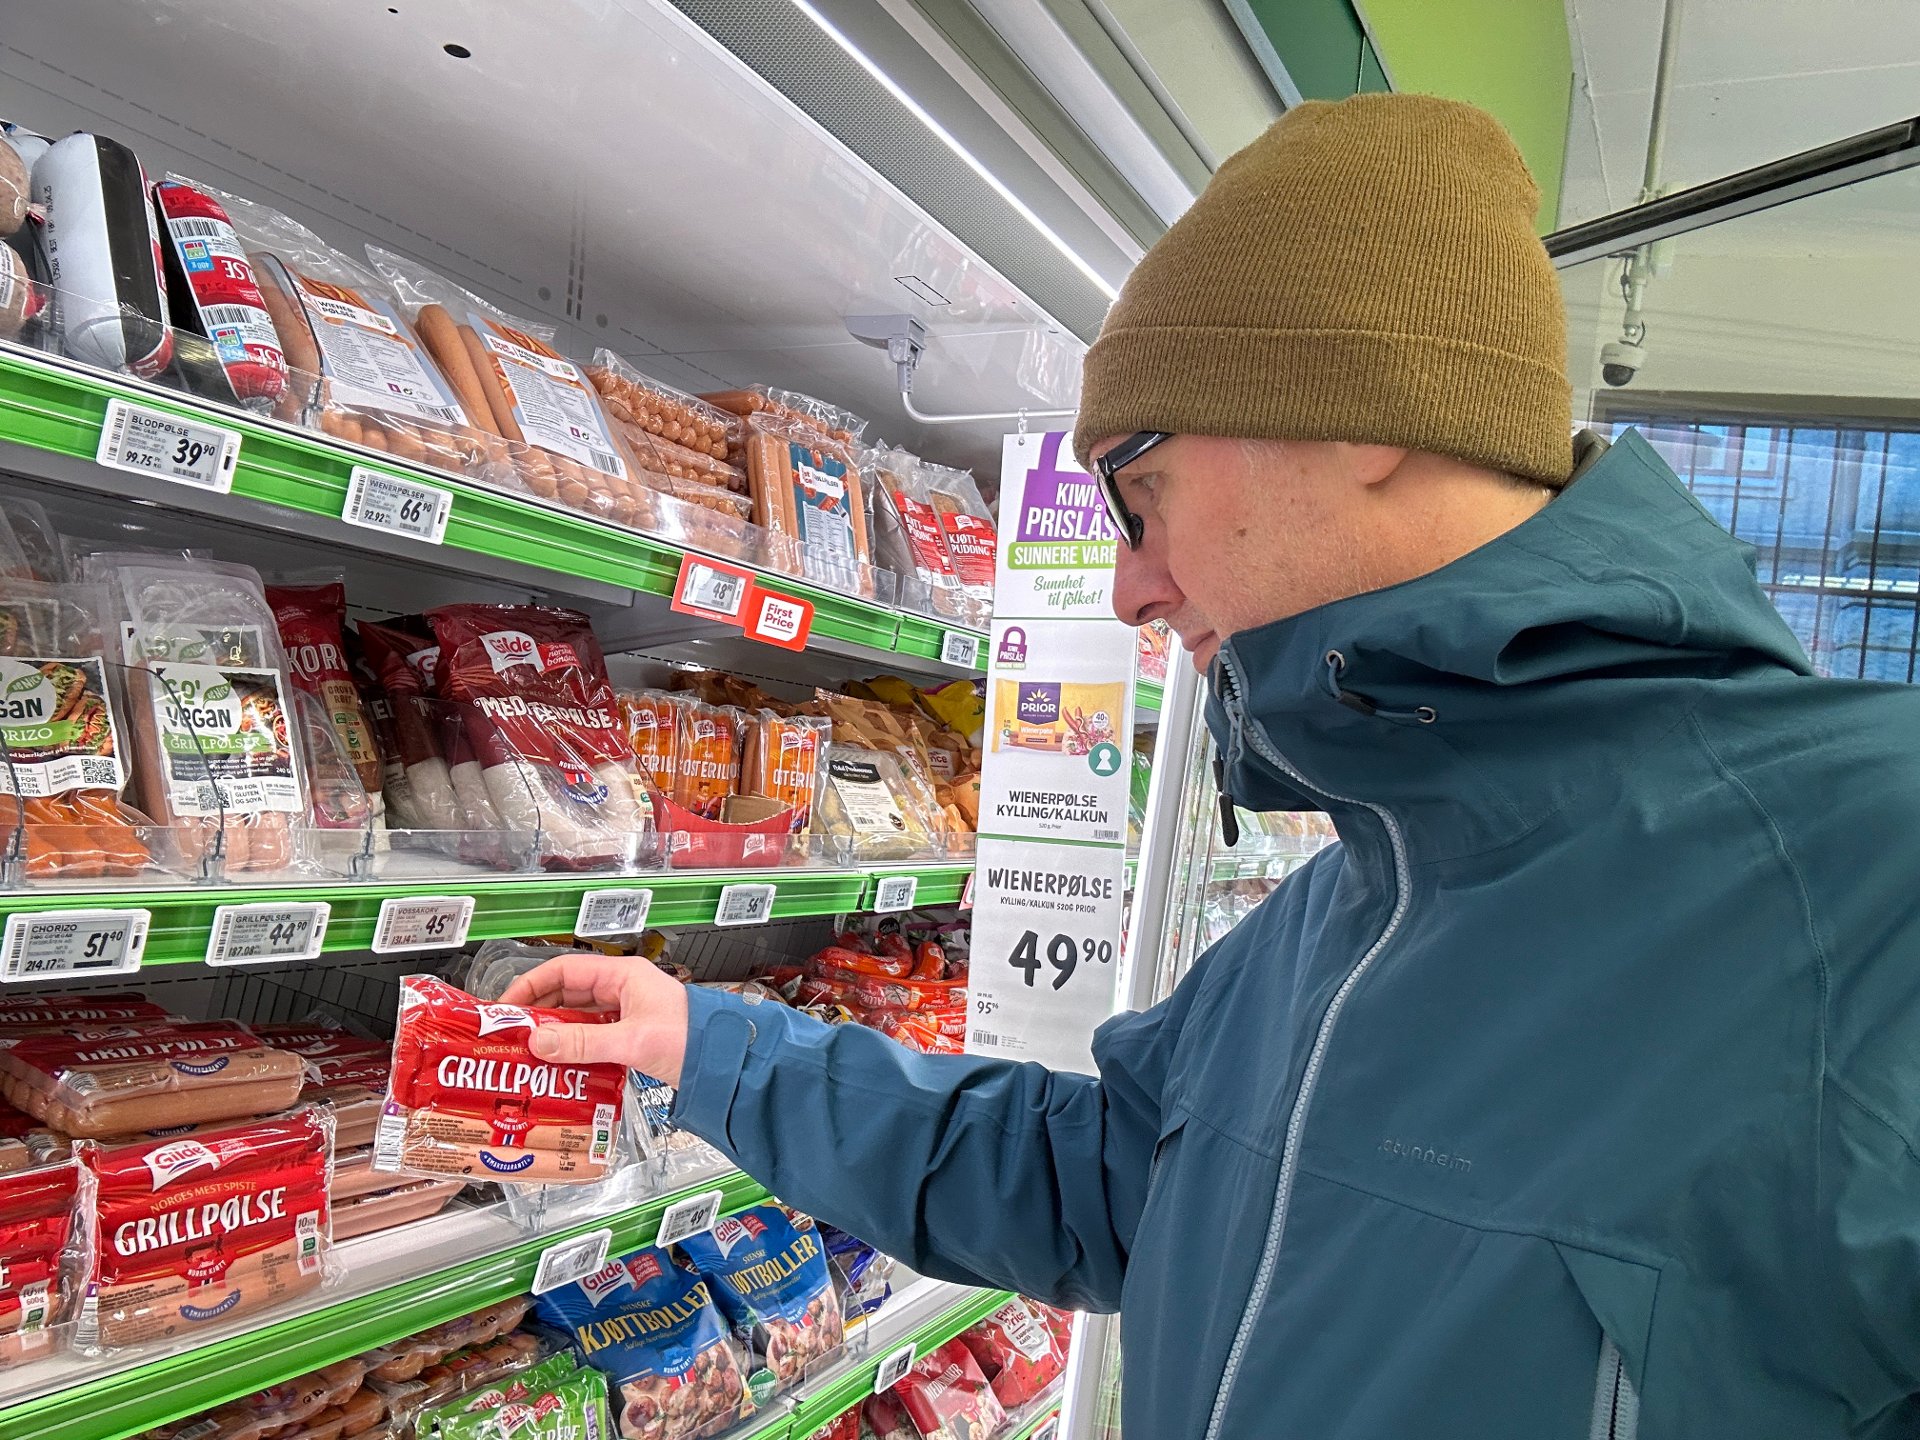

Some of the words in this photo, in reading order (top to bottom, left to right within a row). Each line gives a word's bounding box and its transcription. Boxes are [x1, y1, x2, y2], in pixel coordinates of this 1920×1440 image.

[132, 415, 190, 437] BLODPØLSE
[125, 450, 154, 467] 99.75
[172, 438, 203, 468] 39
[203, 444, 215, 457] 90
[369, 479, 425, 500] WIENERPØLSER
[1055, 482, 1098, 507] KIWI
[363, 509, 385, 523] 92.92
[400, 498, 423, 523] 66
[422, 502, 432, 513] 90
[1025, 503, 1117, 542] PRISLÅS
[948, 532, 979, 546] KJØTT-
[951, 543, 990, 557] PUDDING
[1014, 546, 1078, 566] SUNNERE
[712, 582, 728, 600] 48
[1033, 574, 1086, 592] Sunnhet
[1047, 591, 1061, 606] til
[766, 602, 793, 619] First
[764, 612, 794, 629] Price
[489, 635, 533, 655] Gilde
[1020, 702, 1057, 714] PRIOR
[235, 790, 259, 798] GLUTEN
[245, 796, 263, 804] SOYA
[1009, 790, 1098, 807] WIENERPØLSE
[996, 804, 1108, 824] KYLLING/KALKUN
[987, 868, 1113, 900] WIENERPØLSE
[398, 907, 439, 915] VOSSAKORV
[617, 904, 631, 922] 41
[747, 896, 760, 913] 56
[1000, 896, 1055, 909] KYLLING/KALKUN
[1075, 903, 1096, 914] PRIOR
[235, 913, 292, 923] GRILLPØLSER
[425, 914, 448, 935] 45
[31, 924, 78, 933] CHORIZO
[269, 922, 297, 946] 44
[296, 921, 308, 931] 90
[84, 931, 110, 958] 51
[228, 945, 255, 958] 187.08
[25, 958, 57, 972] 214.17
[1007, 929, 1078, 992] 49
[1082, 937, 1112, 964] 90
[482, 1005, 526, 1020] Gilde
[977, 1000, 992, 1014] 95
[473, 1045, 510, 1056] NORGES
[510, 1045, 529, 1056] MES
[437, 1055, 590, 1101] GRILLPØLSE
[493, 1119, 511, 1131] NORSK
[154, 1144, 207, 1169] Gilde
[485, 1156, 529, 1172] SMAKSGARANTI
[150, 1190, 195, 1214] NORGES
[194, 1183, 222, 1200] MEST
[223, 1180, 257, 1192] SPISTE
[114, 1186, 287, 1257] GRILLPØLSE
[690, 1208, 704, 1226] 49
[714, 1218, 742, 1242] Gilde
[582, 1261, 624, 1291] Gilde
[577, 1281, 713, 1356] KJØTTBOLLER
[994, 1303, 1016, 1322] First
